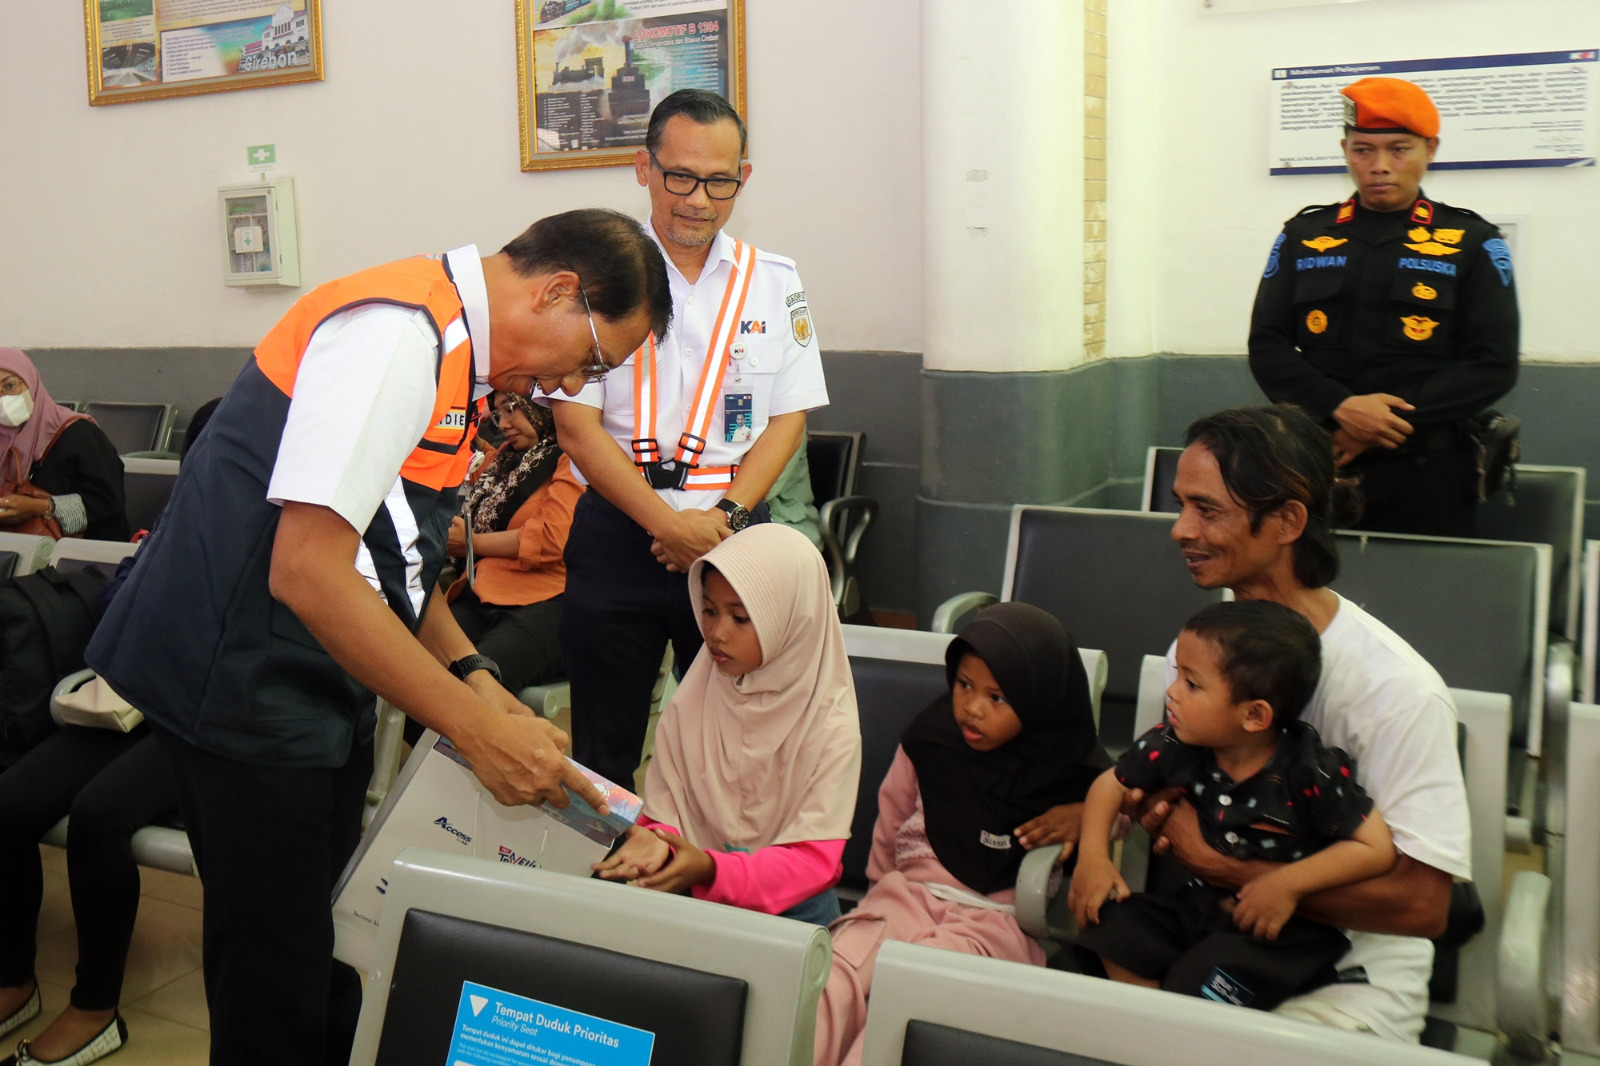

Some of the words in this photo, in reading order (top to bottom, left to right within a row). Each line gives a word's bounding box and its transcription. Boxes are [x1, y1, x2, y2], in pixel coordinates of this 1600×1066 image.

[633, 23, 687, 41] LOKOMOTIF
[688, 23, 696, 34] B
[1296, 256, 1347, 271] RIDWAN
[1398, 256, 1457, 277] POLSUSKA
[433, 816, 472, 843] Access
[491, 1015, 519, 1031] Priority
[520, 1023, 538, 1036] Seat
[495, 1002, 534, 1023] Tempat
[536, 1014, 571, 1034] Duduk
[573, 1024, 619, 1048] Prioritas
[460, 1033, 494, 1047] memerlukan
[494, 1042, 530, 1058] kenyamanan
[530, 1054, 549, 1064] sesuai
[462, 1024, 482, 1035] Tempat
[482, 1031, 500, 1041] duduk
[501, 1035, 509, 1043] ini
[509, 1038, 526, 1048] dapat
[526, 1042, 547, 1054] ditukar
[547, 1049, 561, 1059] bagi
